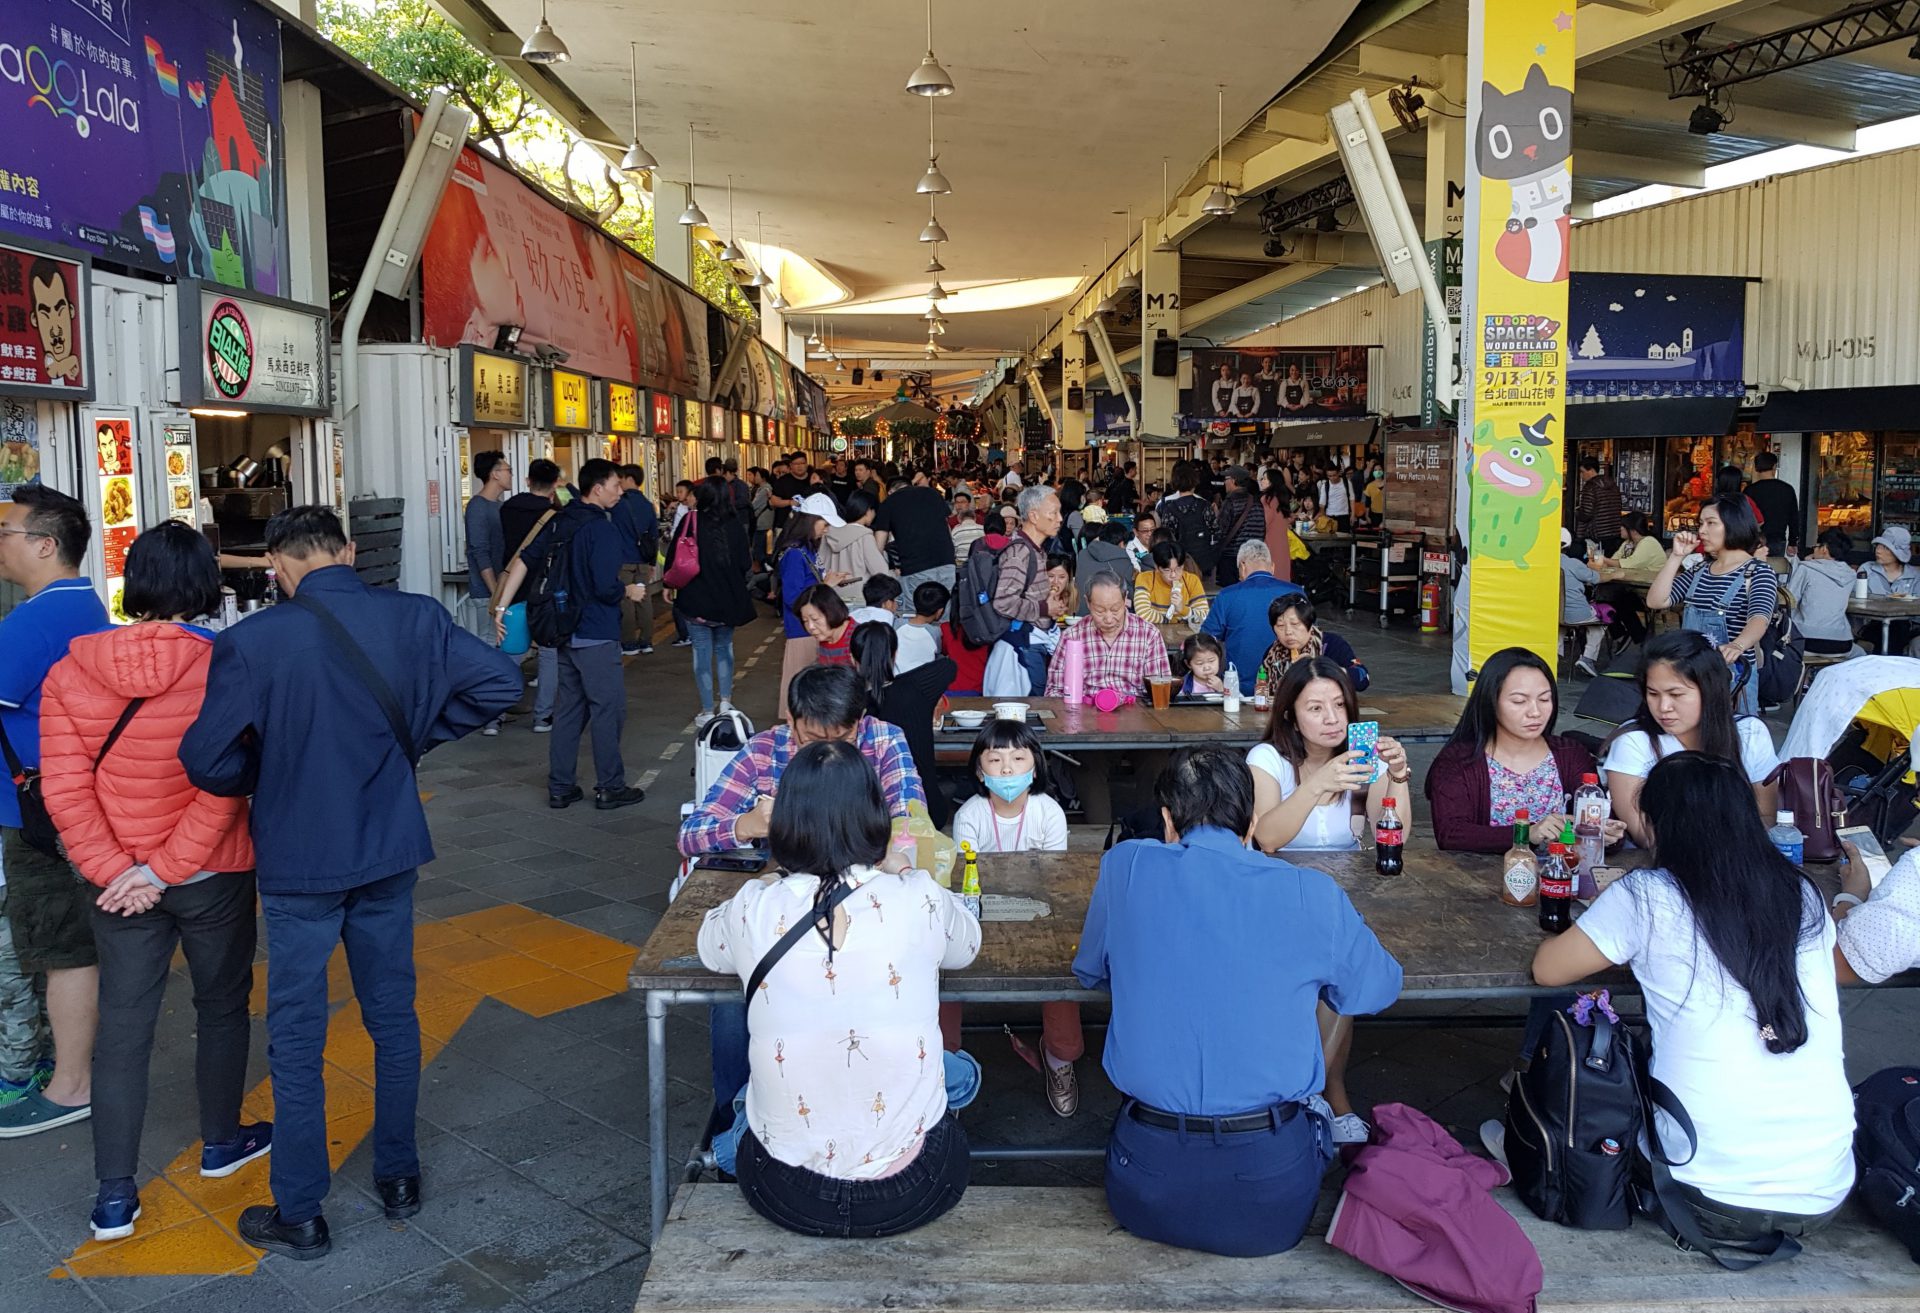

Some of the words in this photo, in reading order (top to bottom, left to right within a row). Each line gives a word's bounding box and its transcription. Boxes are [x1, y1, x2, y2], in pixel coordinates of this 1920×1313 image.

[1485, 326, 1536, 340] SPACE
[1485, 341, 1557, 350] WONDERLAND
[1485, 352, 1558, 368] 宇宙喵樂園
[219, 380, 239, 395] MAJI
[1484, 388, 1556, 400] 台北圓山花博
[1395, 444, 1441, 470] 回收區
[1507, 877, 1535, 885] TABASCO
